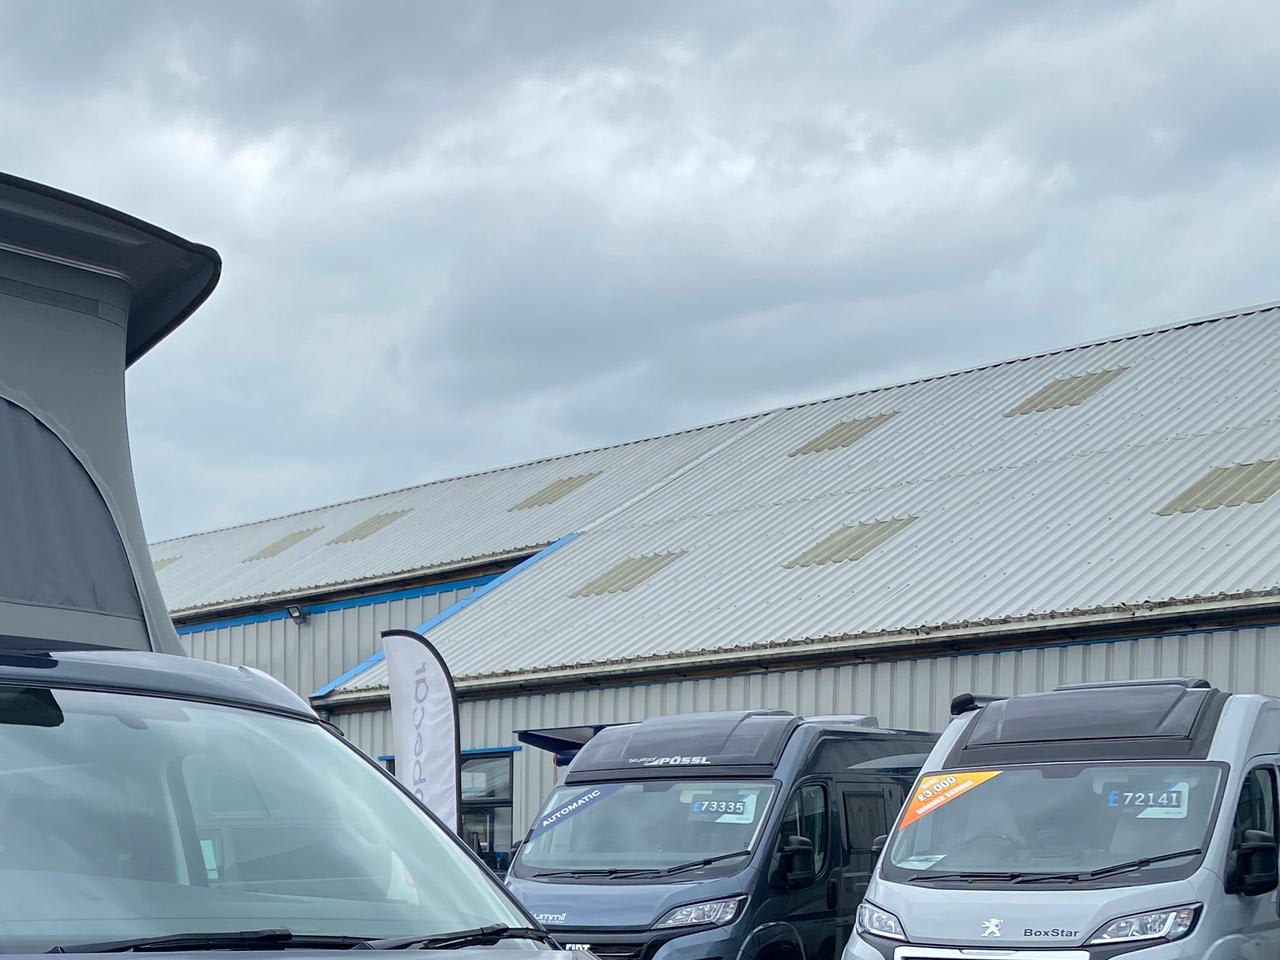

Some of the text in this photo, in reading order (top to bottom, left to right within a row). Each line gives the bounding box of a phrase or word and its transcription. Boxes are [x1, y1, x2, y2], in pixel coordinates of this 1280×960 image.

[659, 755, 711, 765] PÖSSL
[542, 789, 601, 828] AUTOMATIC
[533, 912, 567, 921] ummit
[1023, 928, 1080, 937] BoxStar
